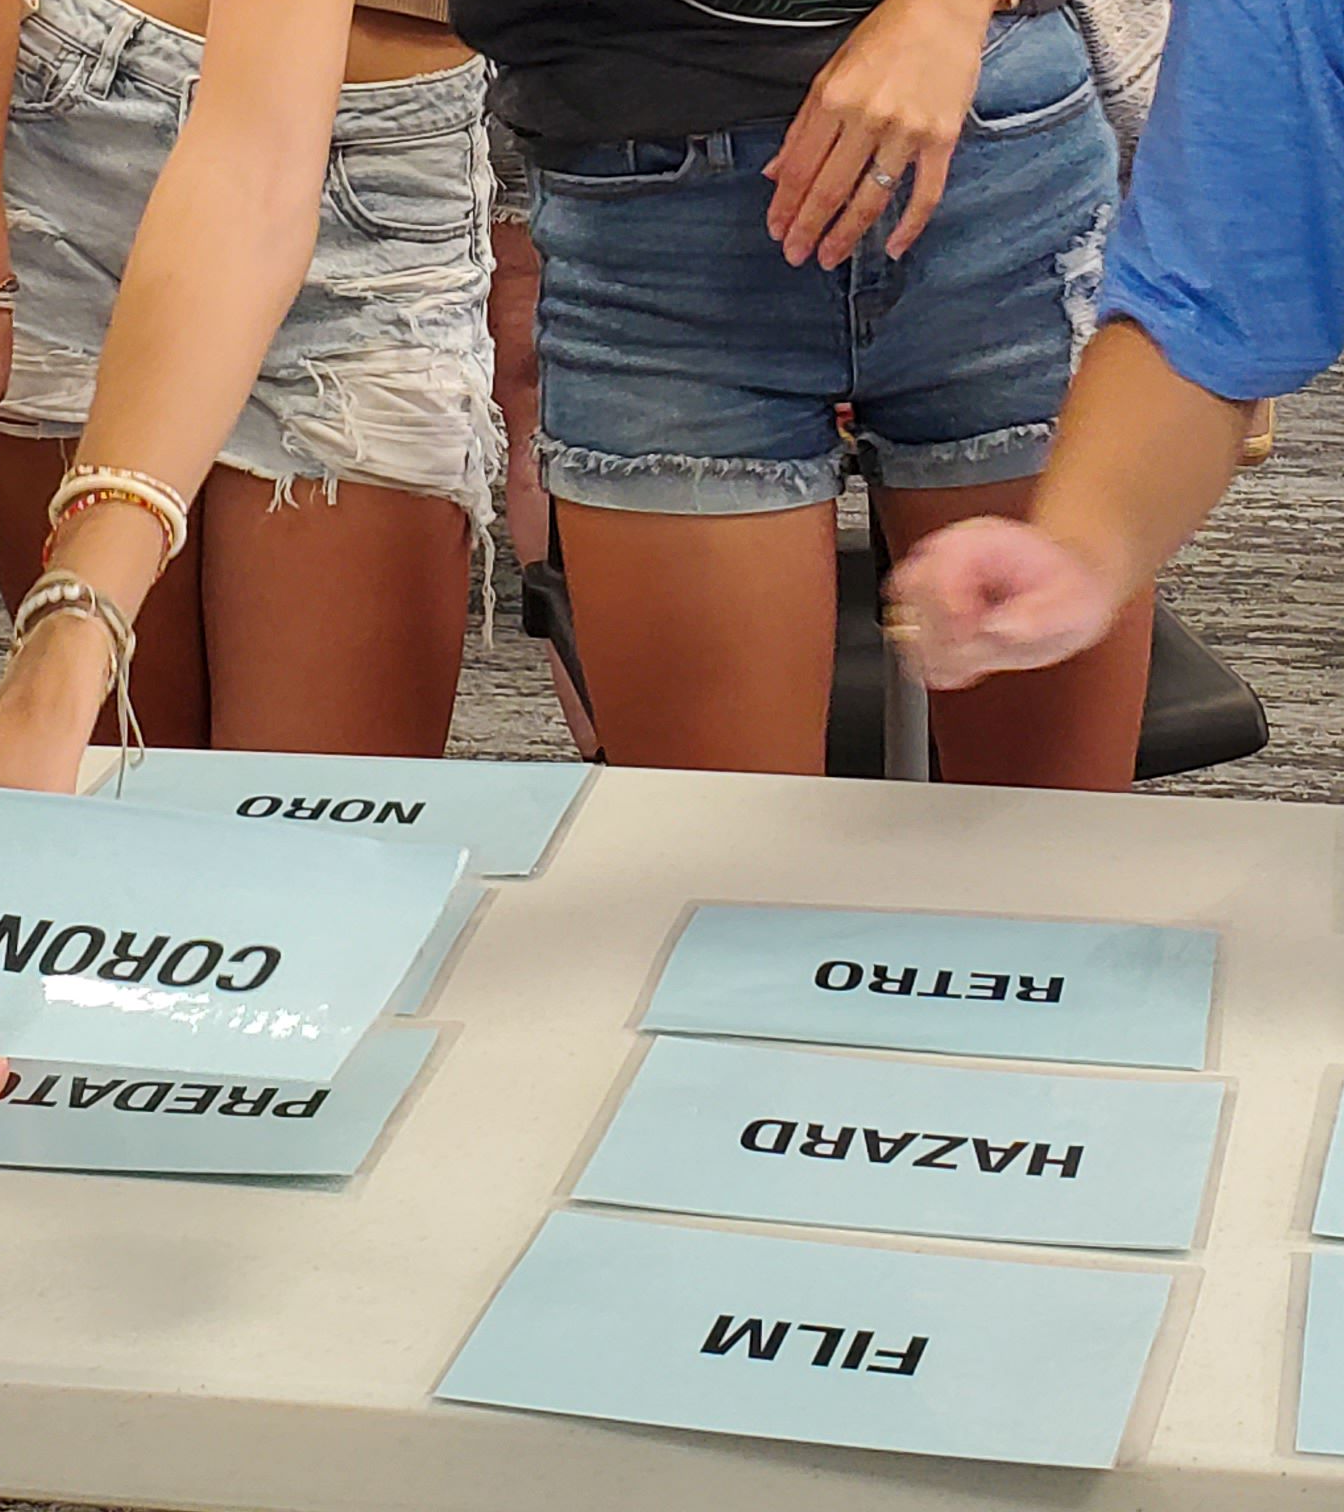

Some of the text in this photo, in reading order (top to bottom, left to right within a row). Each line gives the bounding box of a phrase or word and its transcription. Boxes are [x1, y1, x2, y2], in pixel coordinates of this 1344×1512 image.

[236, 795, 426, 825] NORO
[814, 960, 1065, 1003] RETRO
[740, 1119, 1084, 1179] HAZARD
[700, 1314, 930, 1376] FILM
